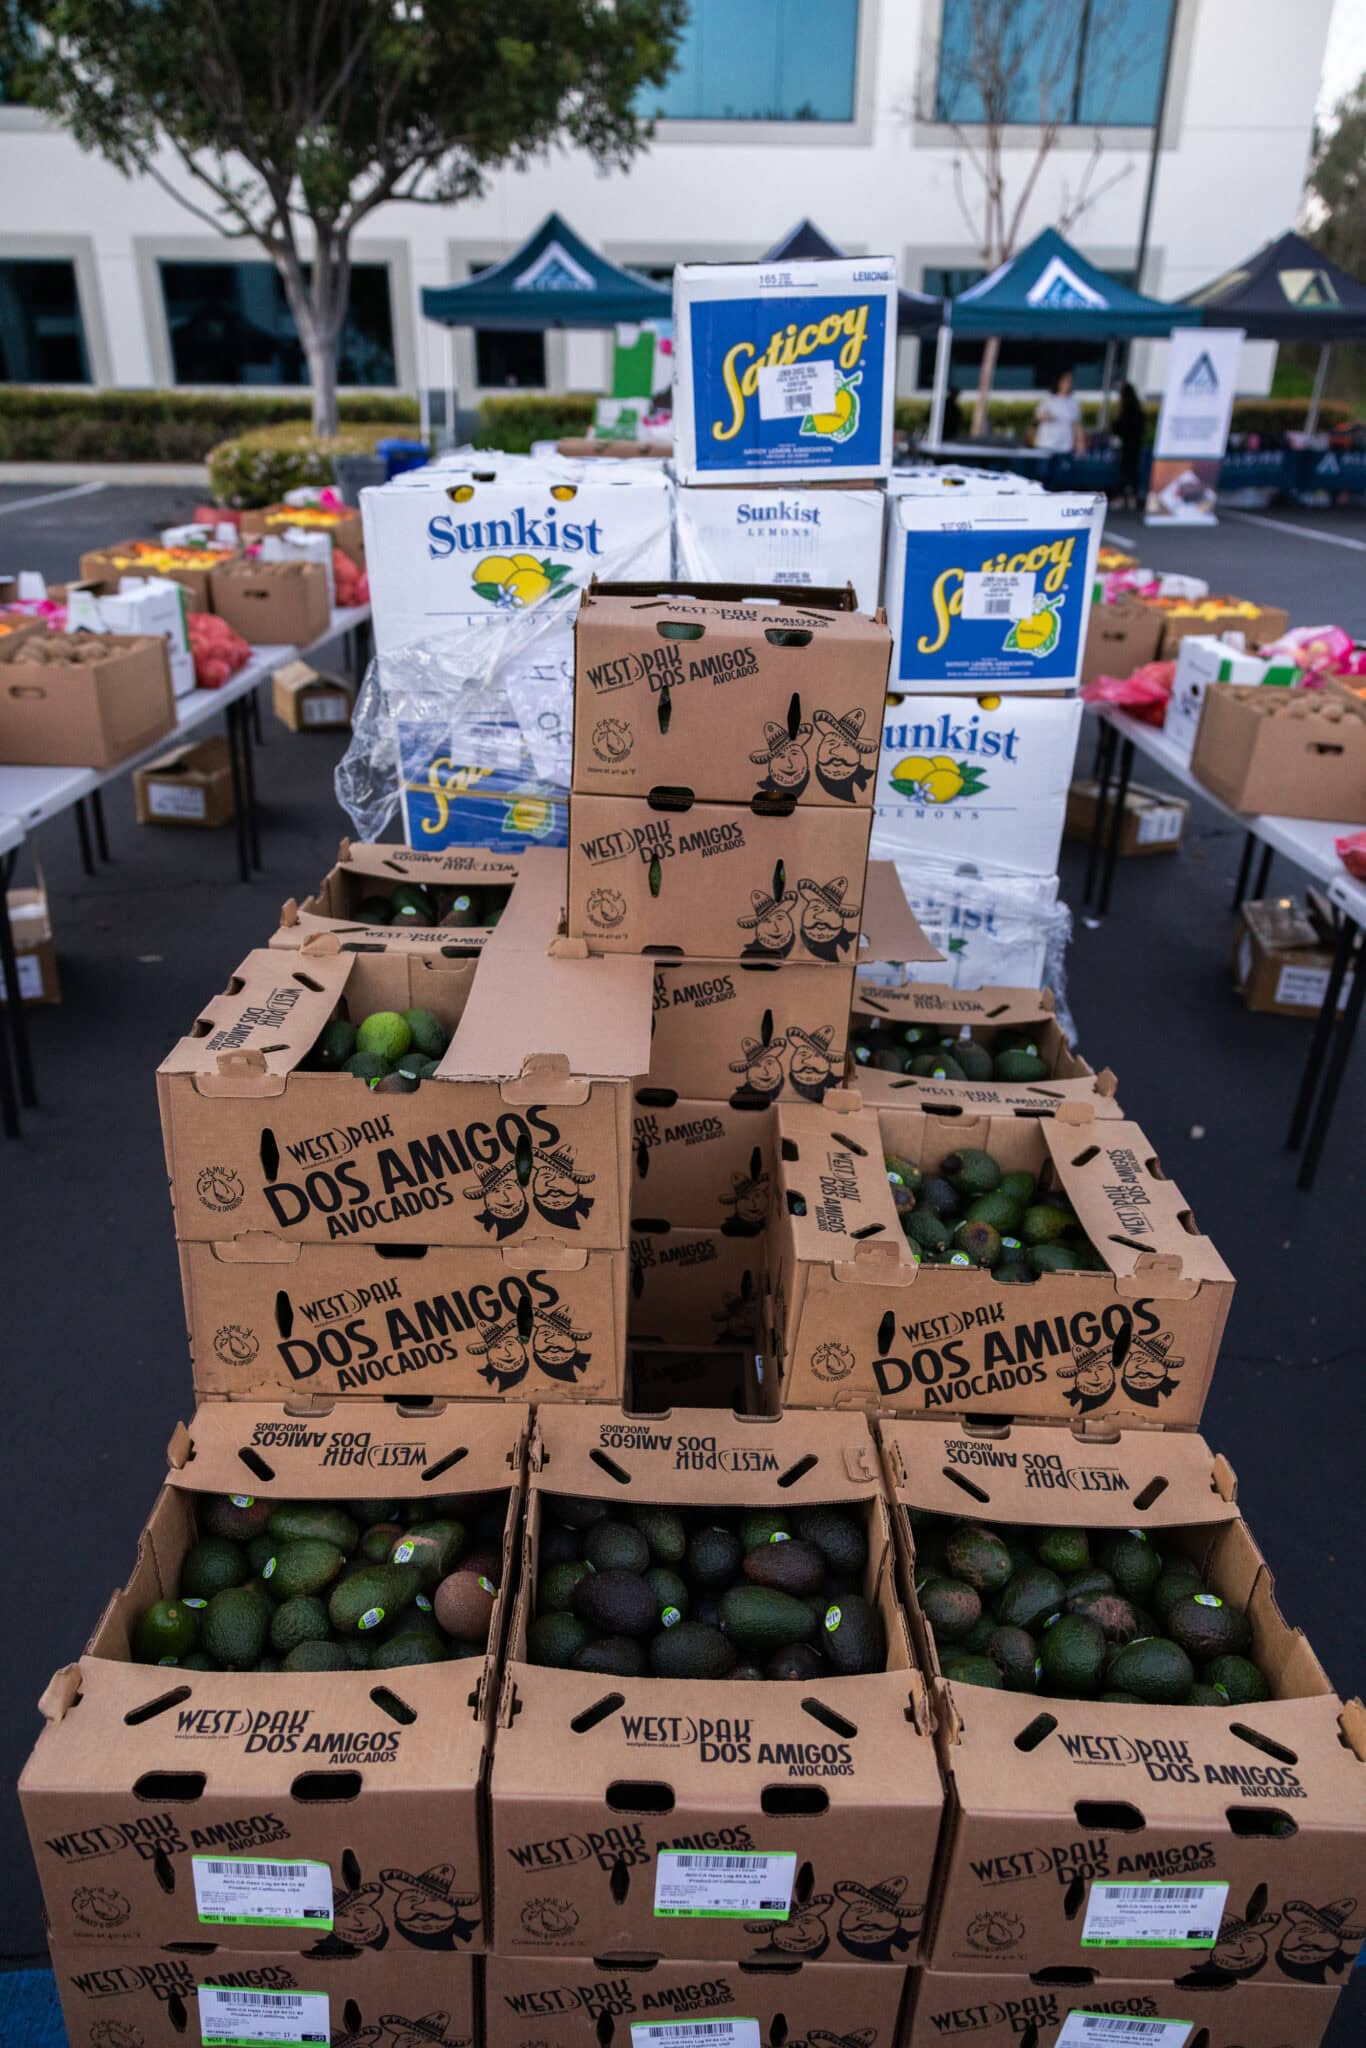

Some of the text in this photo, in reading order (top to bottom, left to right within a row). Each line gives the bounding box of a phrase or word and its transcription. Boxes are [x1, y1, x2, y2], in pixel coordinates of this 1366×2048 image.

[737, 501, 821, 526] Sunkist
[428, 507, 603, 559] Sunkist
[748, 528, 811, 537] LEMONS
[586, 645, 683, 692] WEST PAK
[648, 647, 757, 693] DOS AMIGOS
[713, 663, 759, 687] AVOCADOS
[884, 714, 1020, 763] unkist
[879, 809, 980, 820] LEMONS
[581, 819, 672, 861] WEST PAK
[640, 822, 743, 864] DOS AMIGOS
[701, 838, 746, 859] AVOCADOS
[271, 988, 304, 1008] WEST
[673, 976, 734, 1006] AMIGOS
[240, 1007, 263, 1025] DOS
[286, 1114, 394, 1165] WEST PAK
[665, 1116, 724, 1144] AMIGOS
[264, 1105, 561, 1228] DOS AMIGOS
[833, 1152, 856, 1177] WEST
[1106, 1149, 1151, 1206] DOS AMIGOS
[326, 1182, 455, 1240] AVOCADOS
[820, 1176, 847, 1235] DOS AMIGOS
[1117, 1211, 1148, 1235] WEST
[299, 1276, 402, 1325] WEST PAK
[276, 1270, 560, 1382] DOS AMIGOS
[901, 1302, 1006, 1342] WEST PAK
[872, 1298, 1160, 1396] DOS AMIGOS
[337, 1338, 459, 1392] AVOCADOS
[924, 1361, 1049, 1409] AVOCADOS
[250, 1431, 371, 1448] DOS AMIGOS
[255, 1422, 308, 1432] AVOCADOS
[600, 1424, 650, 1434] AVOCADOS
[600, 1433, 716, 1451] DOS AMIGOS
[944, 1440, 993, 1451] AVOCADOS
[321, 1446, 428, 1467] WEST PAK
[675, 1450, 780, 1472] WEST PAK
[948, 1449, 1064, 1471] DOS AMIGOS
[1025, 1468, 1130, 1491] WEST PAK
[177, 1709, 310, 1734] WEST PAK
[621, 1716, 752, 1744] WEST PAK
[244, 1731, 402, 1754] DOS AMIGOS
[700, 1742, 853, 1765] DOS AMIGOS
[1058, 1734, 1193, 1765] WEST PAK
[328, 1751, 398, 1765] AVOCADOS
[788, 1764, 855, 1777] AVOCADOS
[1145, 1762, 1300, 1787] DOS AMIGOS
[1240, 1784, 1308, 1799] AVOCADOS
[44, 1812, 182, 1861] WEST PAK
[134, 1812, 285, 1861] DOS AMIGOS
[227, 1829, 291, 1854] AVOCADOS
[509, 1822, 645, 1869] WEST PAK
[599, 1846, 651, 1872] DOS
[970, 1837, 1110, 1882] WEST PAK
[1056, 1842, 1215, 1886] DOS AMIGOS
[1149, 1858, 1217, 1879] AVOCADOS
[70, 1960, 194, 1998] WEST PAK
[154, 1980, 198, 2001] DOS
[505, 1979, 632, 2014] WEST PAK
[589, 1978, 731, 2019] DOS AMIGOS
[674, 1992, 735, 2013] AVOCADOS
[930, 1994, 1059, 2032] WEST PAK
[1011, 2010, 1060, 2034] DOS
